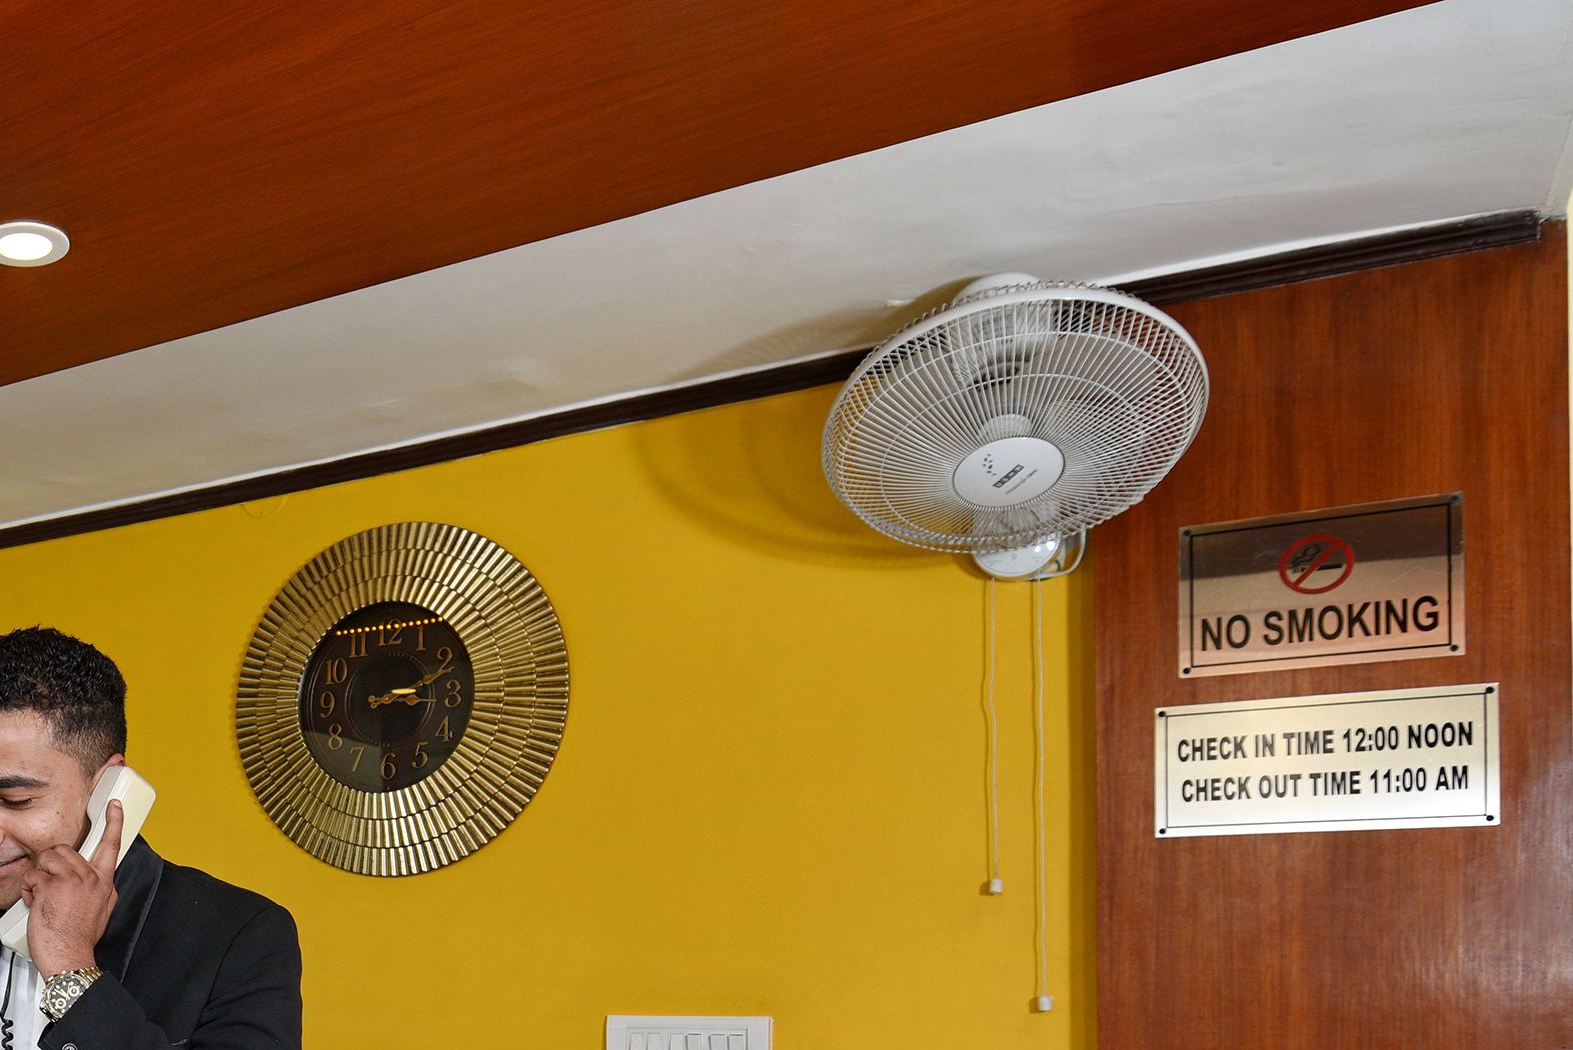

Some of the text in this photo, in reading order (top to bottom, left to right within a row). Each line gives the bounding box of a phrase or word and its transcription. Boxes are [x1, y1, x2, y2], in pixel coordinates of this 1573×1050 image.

[378, 618, 403, 646] 12
[416, 622, 427, 651] 1
[1202, 595, 1440, 651] NO SMOKING
[349, 628, 368, 658] 11
[325, 657, 348, 685] 10
[436, 646, 454, 672] 2
[320, 691, 335, 718] 9
[445, 680, 462, 708] 3
[328, 723, 343, 750] 8
[435, 715, 453, 743] 4
[1178, 721, 1473, 762] CHECK IN TIME 12:00 NOON
[350, 746, 365, 773] 7
[381, 752, 396, 780] 6
[412, 742, 428, 769] 5
[1182, 765, 1468, 802] CHECK OUT TIME 11:00 AM
